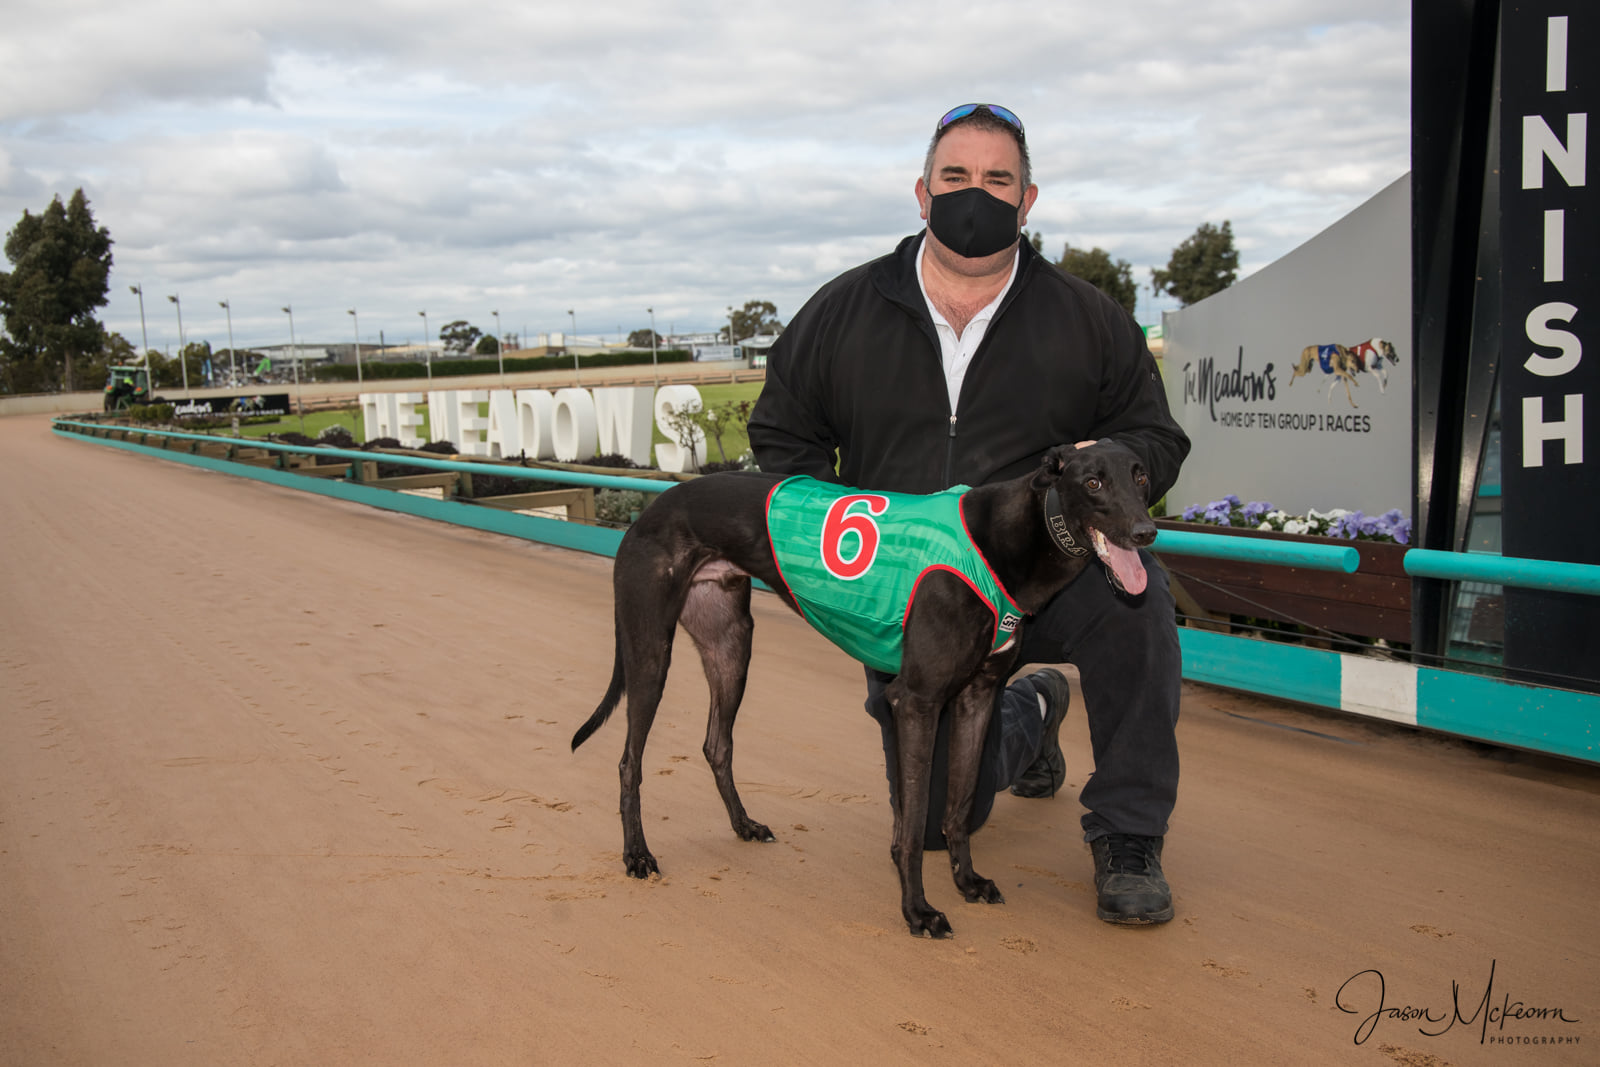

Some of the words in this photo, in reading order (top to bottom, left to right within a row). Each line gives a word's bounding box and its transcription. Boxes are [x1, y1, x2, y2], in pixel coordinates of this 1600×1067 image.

[1198, 345, 1277, 422] Meadows
[359, 391, 427, 449] THE
[427, 384, 708, 474] MEADOWS
[1220, 412, 1243, 427] HOME
[1244, 412, 1256, 428] OF
[1258, 413, 1276, 429] TEN
[1278, 413, 1317, 431] GROUP
[1318, 414, 1324, 431] 1
[1326, 415, 1371, 433] RACES
[820, 494, 890, 580] 6
[1050, 515, 1089, 557] BRA
[1002, 615, 1019, 628] GR
